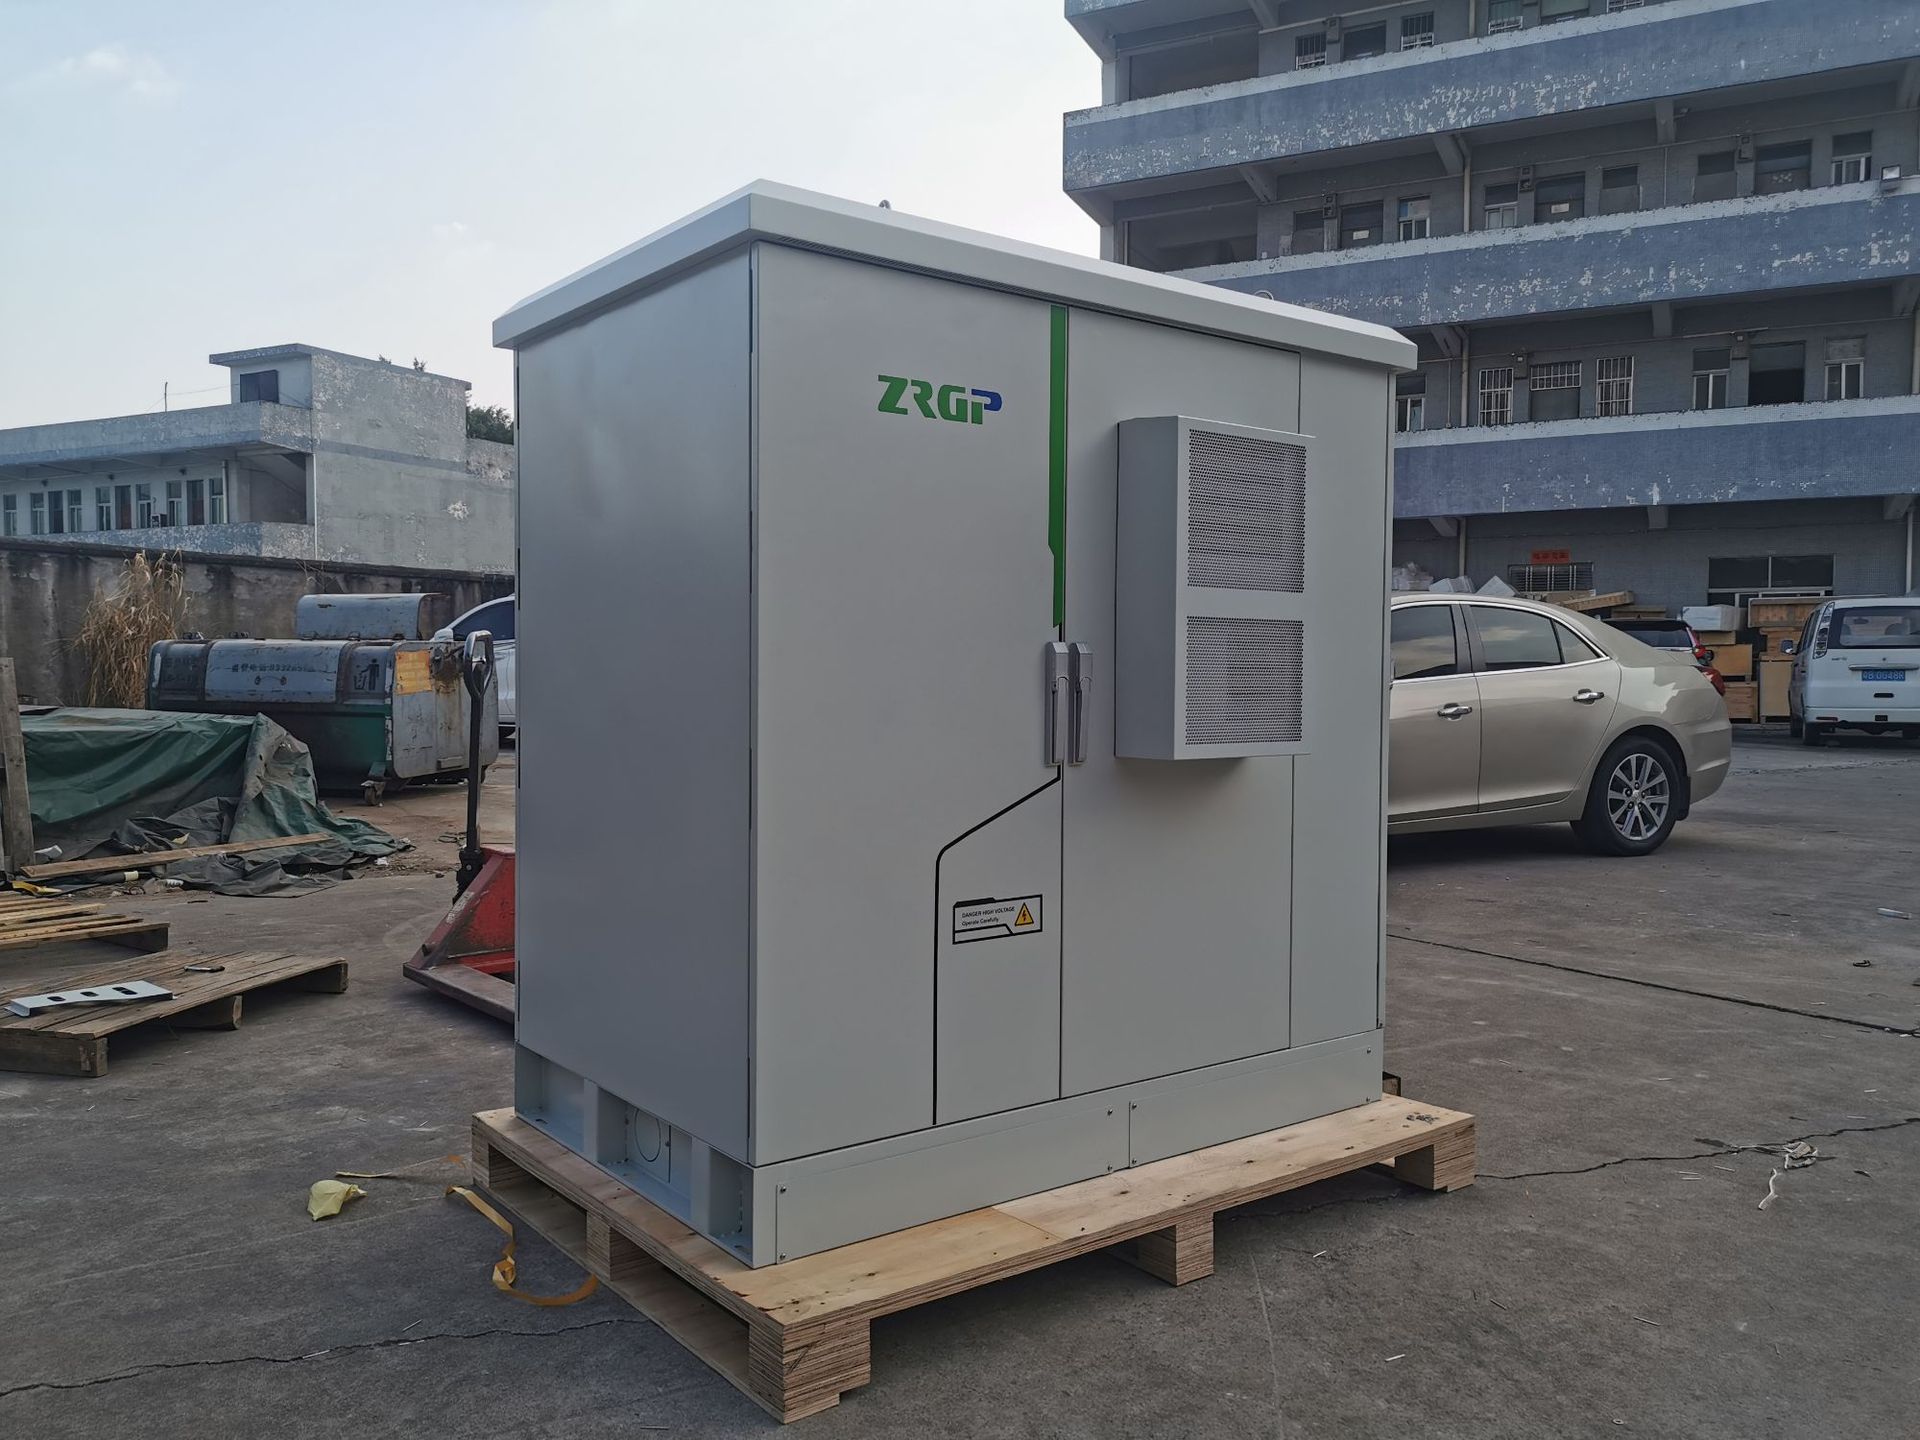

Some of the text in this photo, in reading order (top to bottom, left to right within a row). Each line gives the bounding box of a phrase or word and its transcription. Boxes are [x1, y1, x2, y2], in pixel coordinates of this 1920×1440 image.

[994, 906, 1015, 914] VOLTAGE
[961, 916, 999, 927] Operate Carefully
